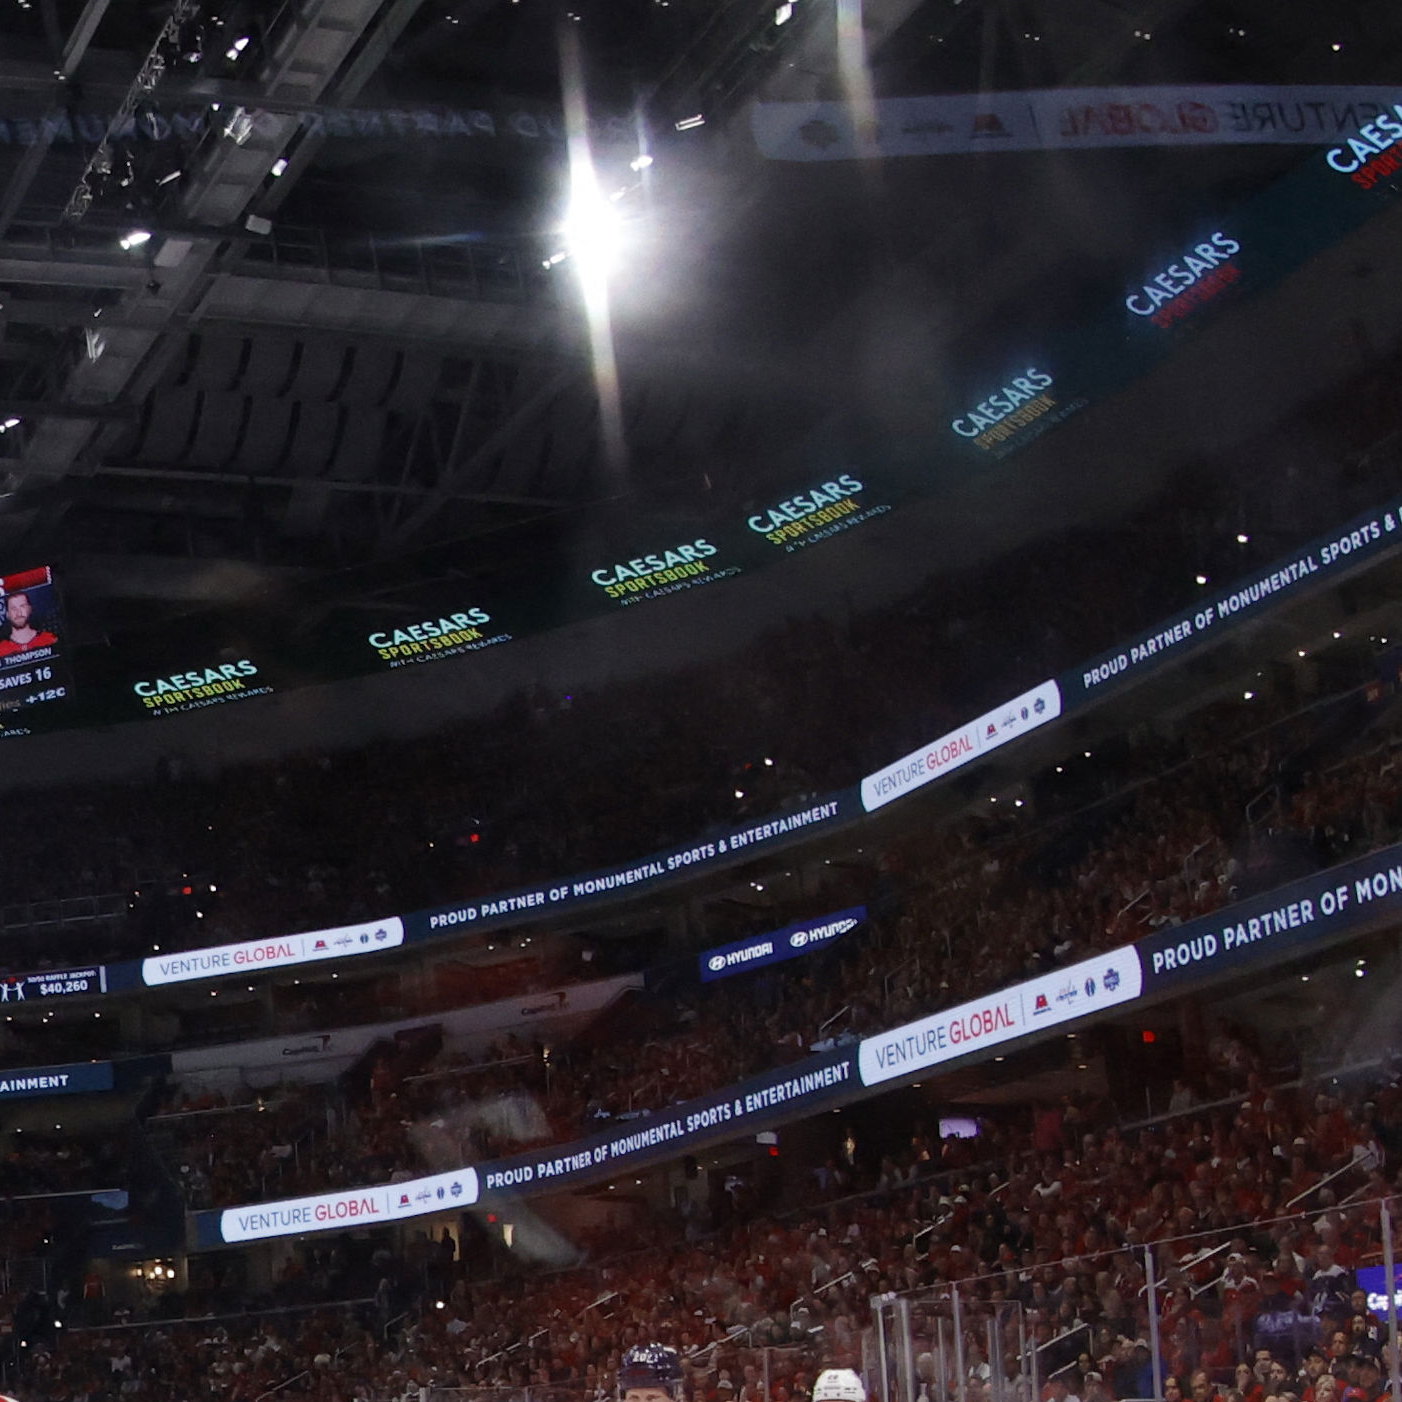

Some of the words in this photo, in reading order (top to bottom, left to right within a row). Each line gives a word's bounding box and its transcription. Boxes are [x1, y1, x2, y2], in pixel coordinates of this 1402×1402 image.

[368, 607, 490, 651] CAESARS
[36, 667, 51, 681] 16
[873, 757, 926, 799] VENTURE
[925, 734, 973, 771] GLOBAL
[430, 908, 477, 929] PROUD
[481, 892, 545, 918] PARTNER
[549, 887, 568, 902] OF
[573, 861, 665, 896] MONUMENTAL
[667, 844, 715, 870] SPORTS
[718, 840, 727, 854] &
[729, 801, 838, 849] ENTERTAINMENT
[726, 941, 773, 966] HYUNDAI
[1151, 934, 1218, 974] PROUD
[1223, 903, 1315, 950] PARTNER
[1320, 885, 1349, 915] OF
[39, 979, 88, 995] $40,260
[876, 1025, 947, 1071] VENTURE
[949, 1001, 1015, 1045] GLOBAL
